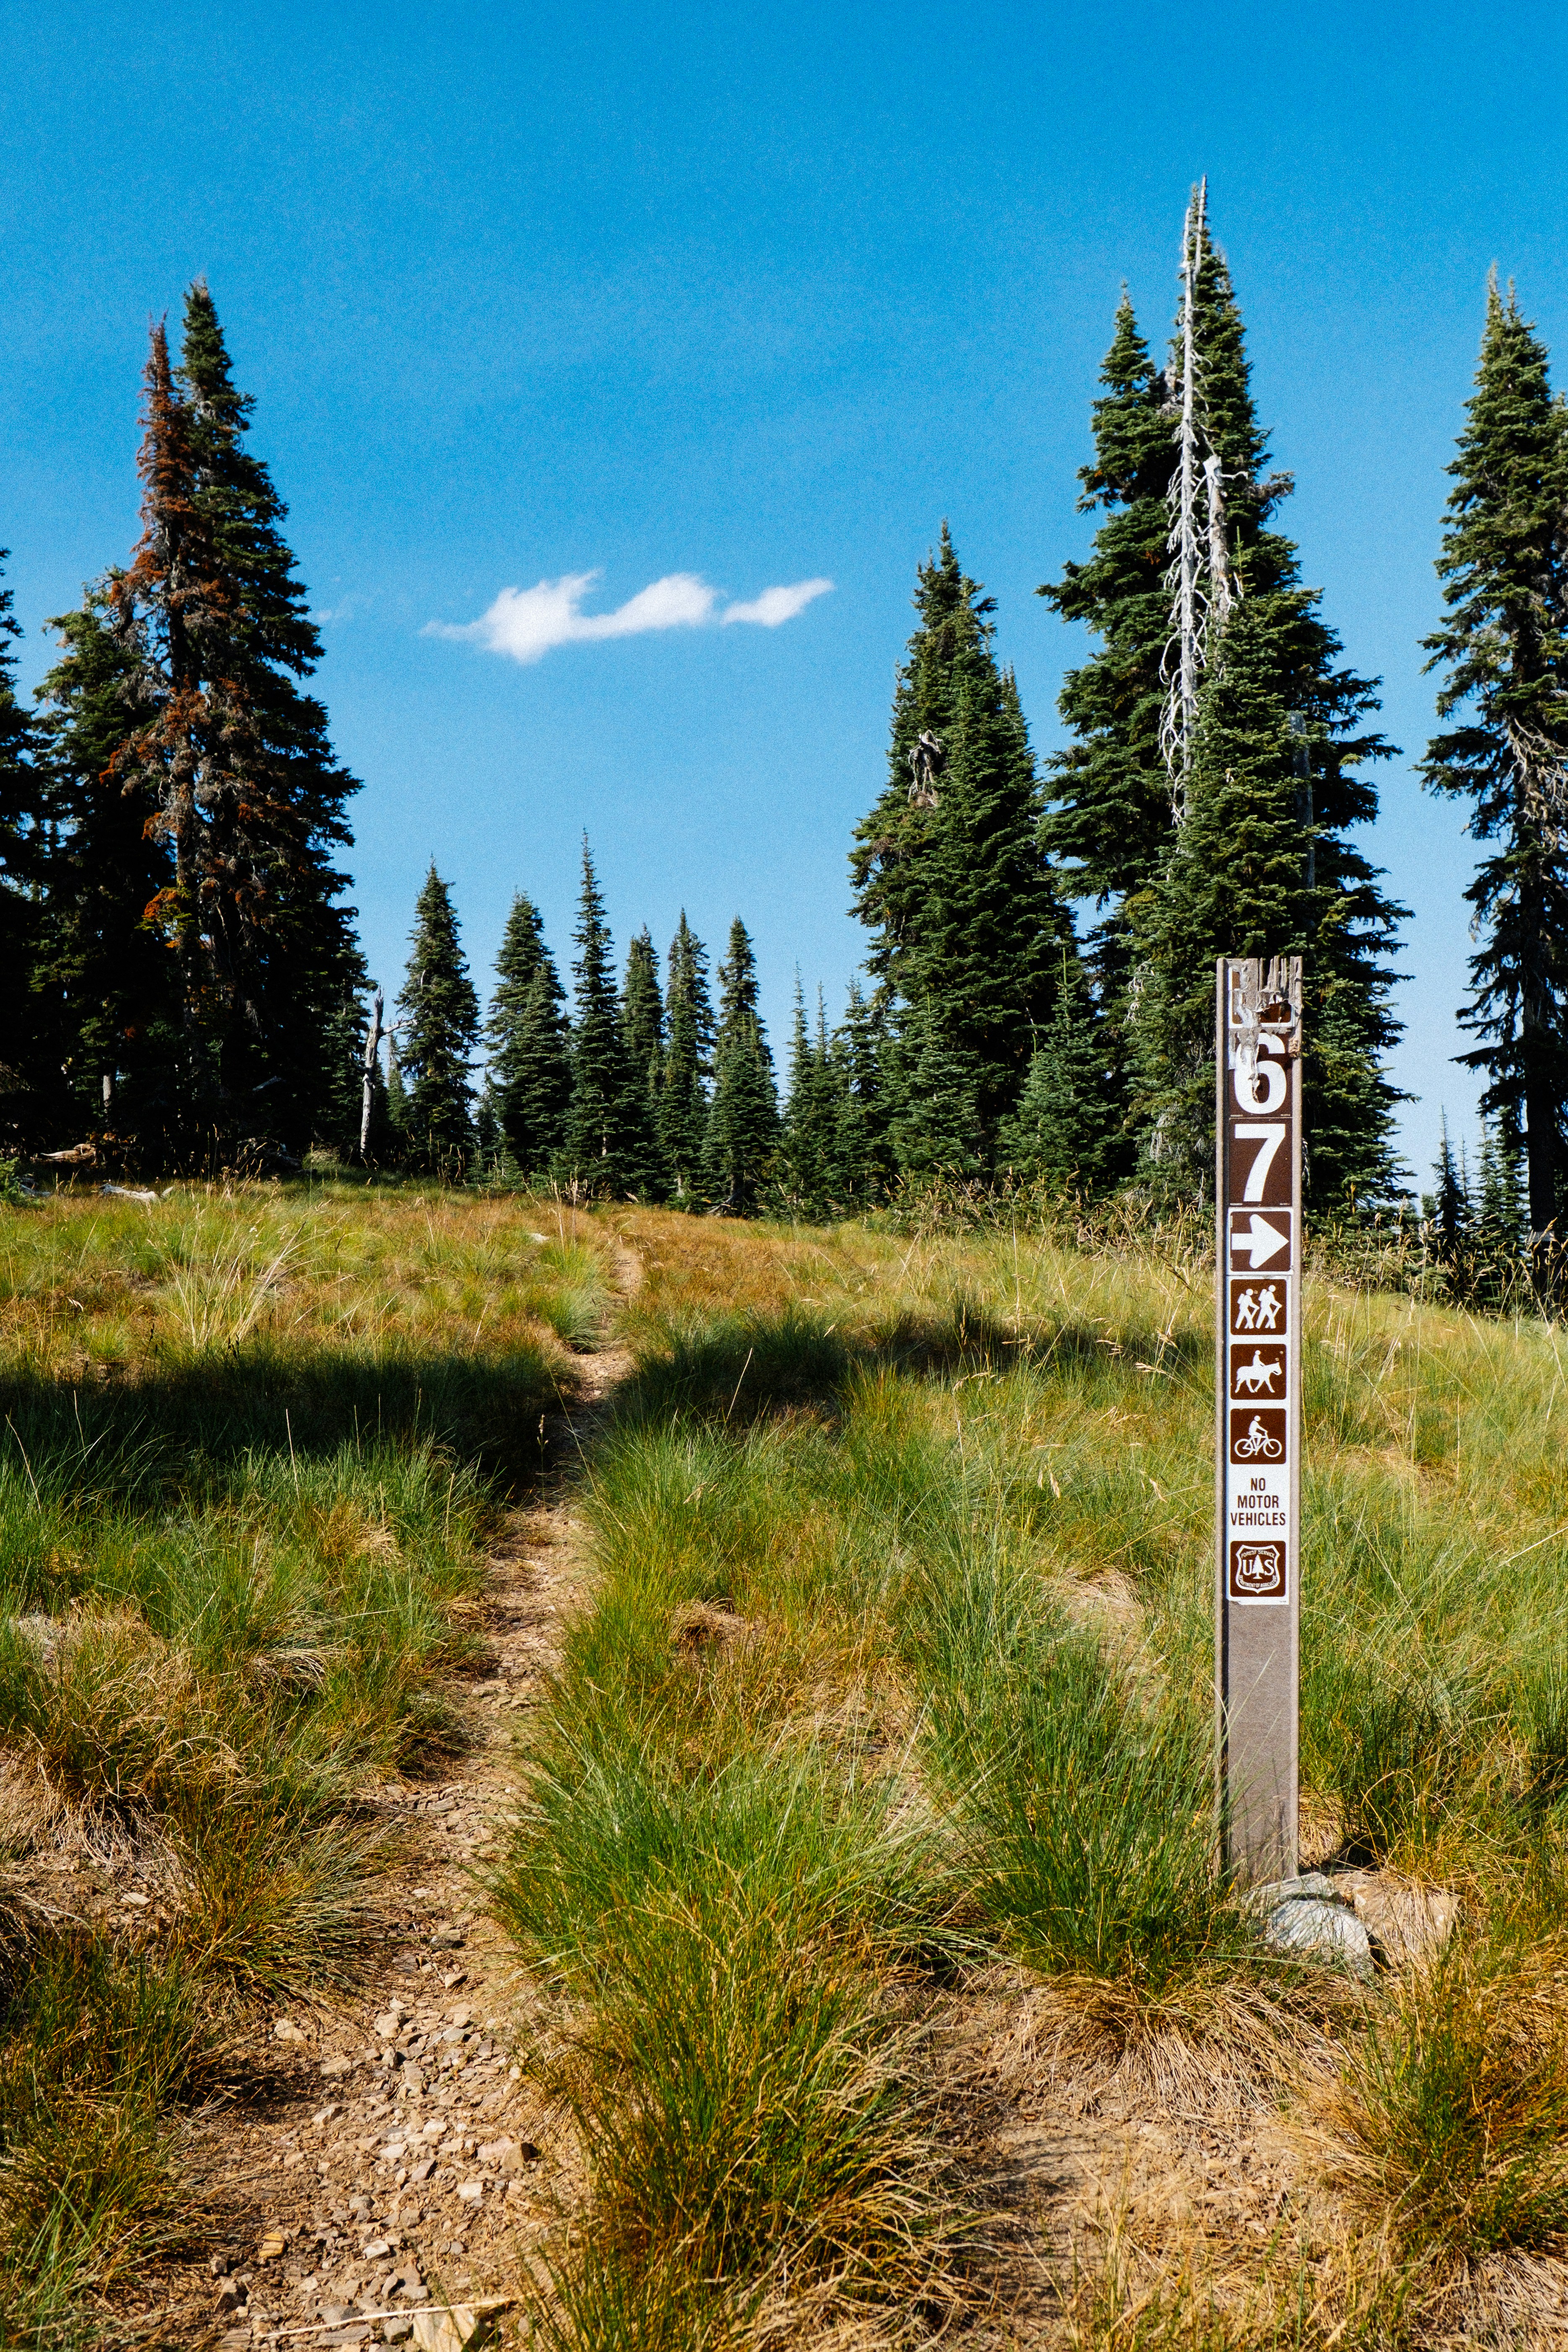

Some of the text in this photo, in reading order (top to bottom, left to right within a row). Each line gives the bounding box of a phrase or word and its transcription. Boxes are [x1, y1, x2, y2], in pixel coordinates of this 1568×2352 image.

[1234, 1032, 1287, 1114] 6
[1234, 1124, 1286, 1202] 7
[1251, 1478, 1265, 1491] NO
[1238, 1495, 1279, 1508] MOTOR
[1231, 1512, 1286, 1525] VEHICLES
[1242, 1559, 1275, 1576] U S
